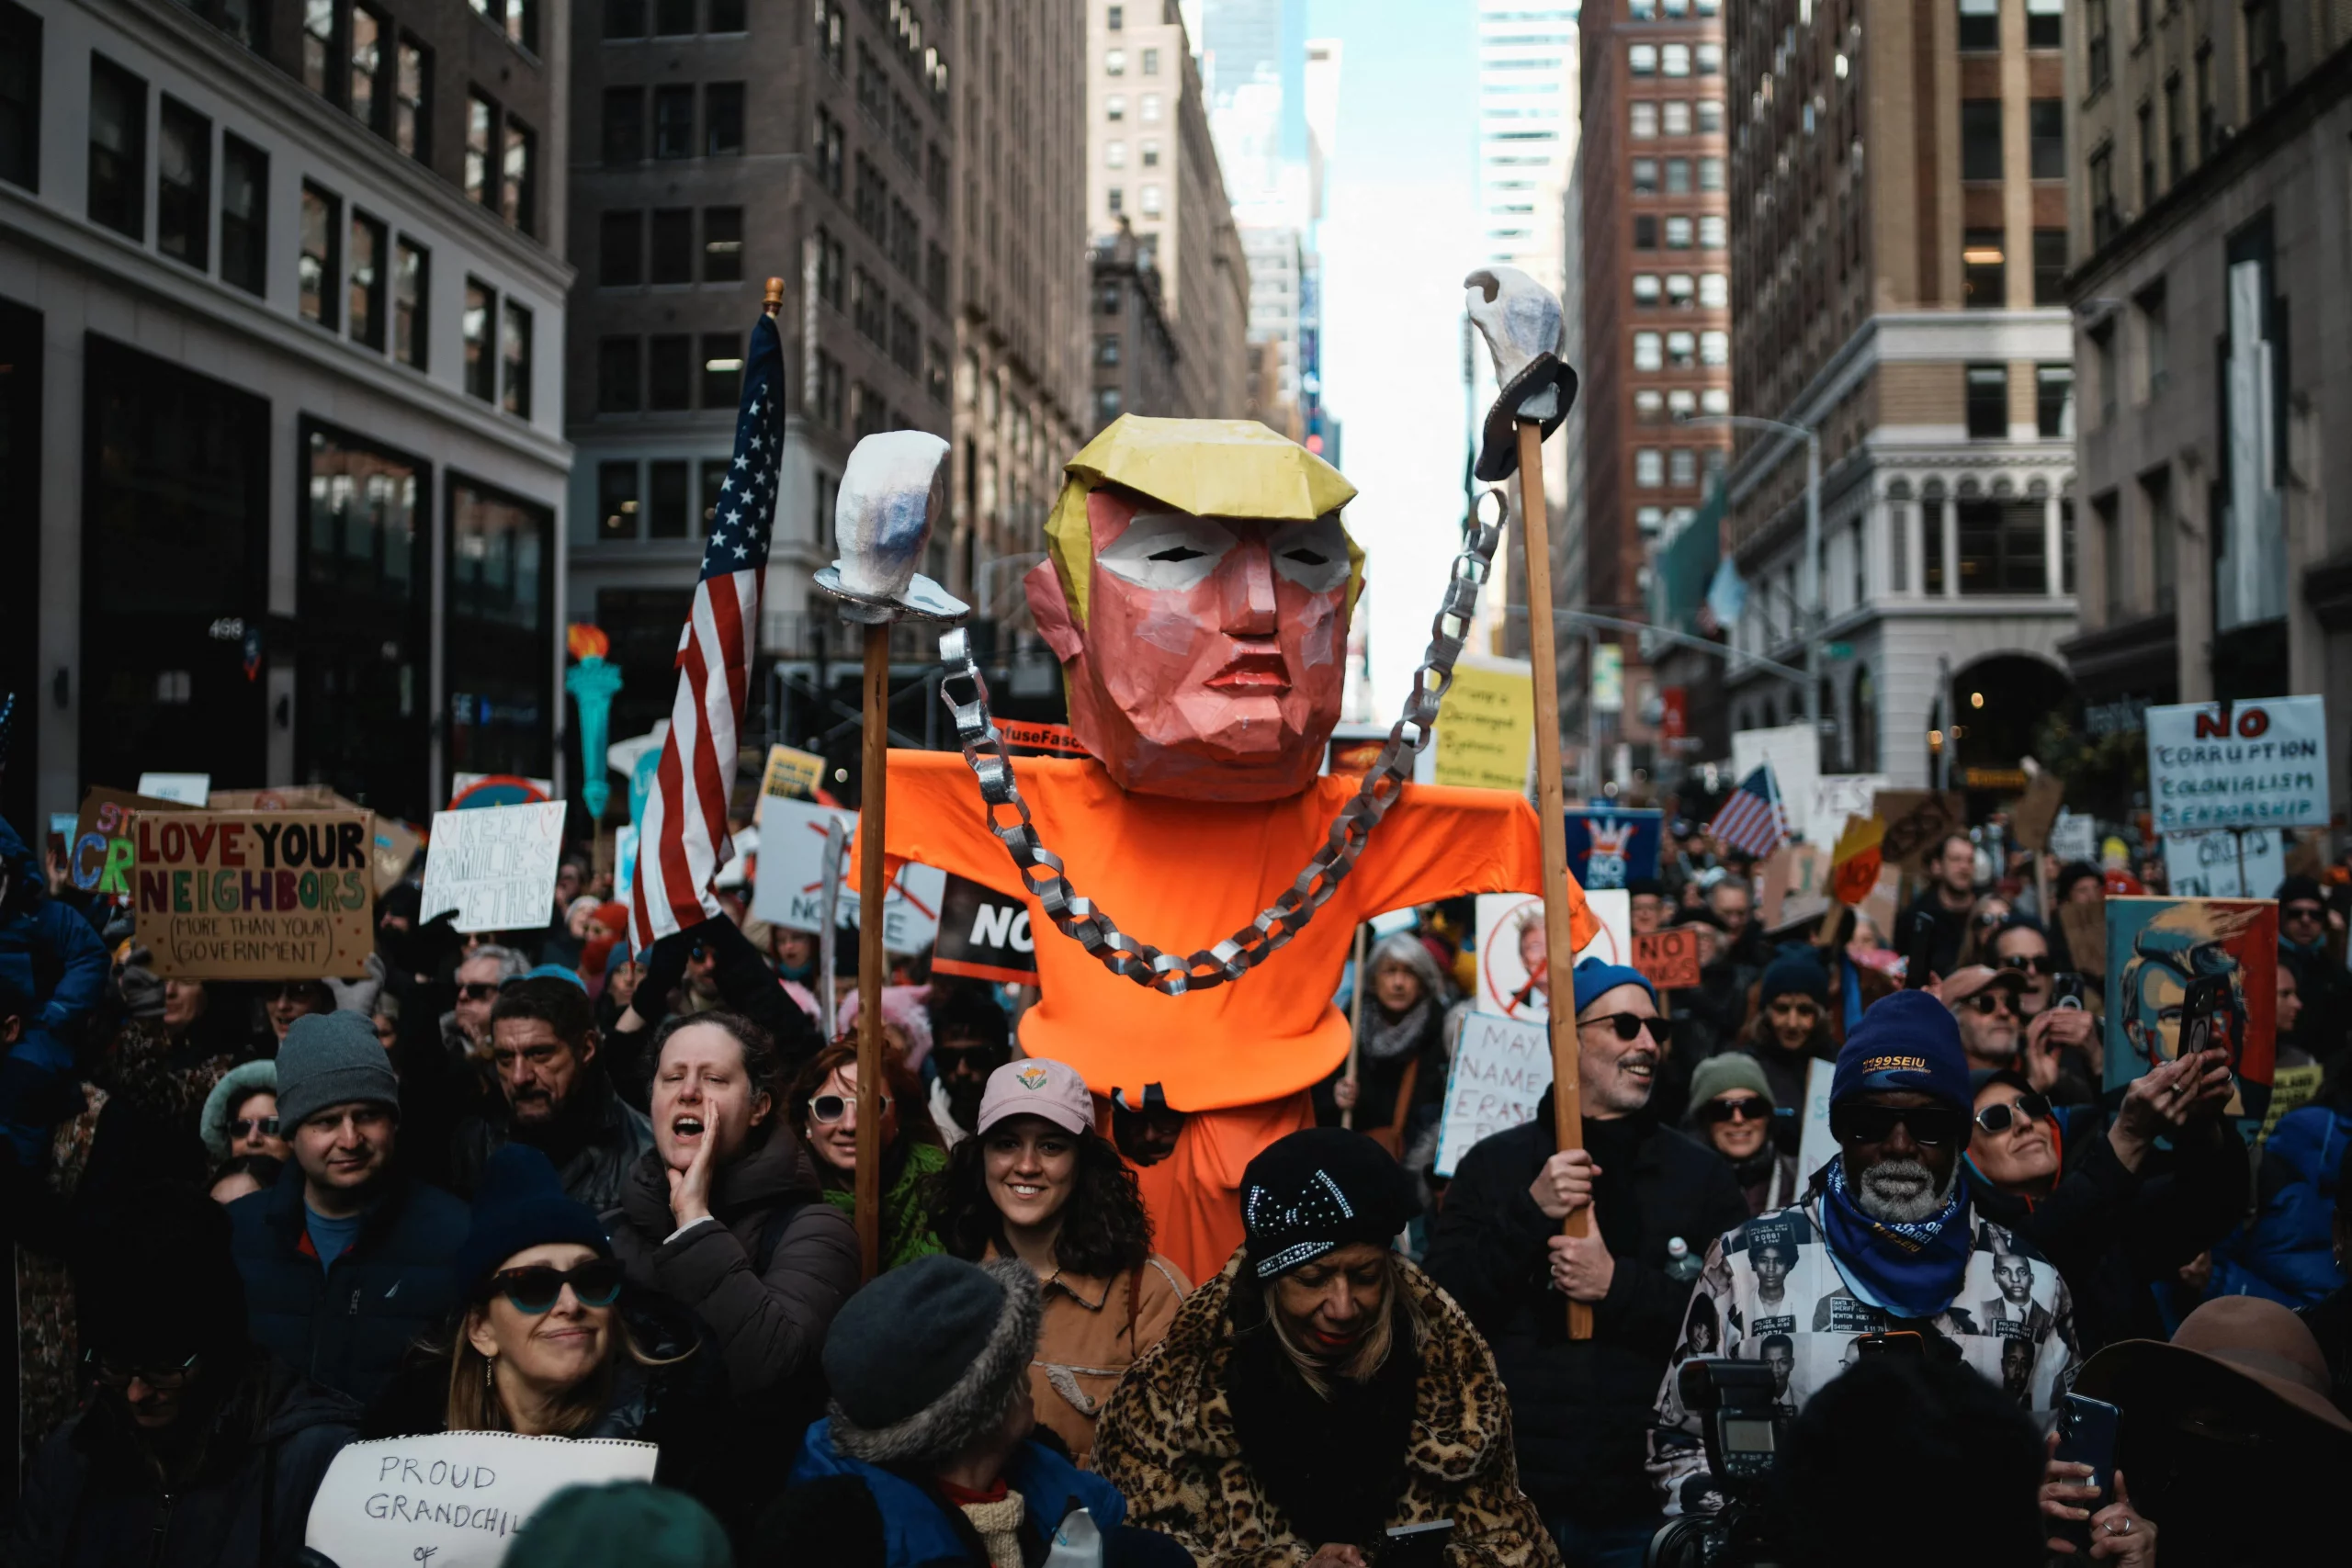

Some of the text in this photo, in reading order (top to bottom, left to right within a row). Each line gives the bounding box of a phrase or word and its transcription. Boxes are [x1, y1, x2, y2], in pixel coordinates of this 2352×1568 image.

[999, 725, 1085, 750] fuseFasc
[2194, 706, 2270, 740] NO
[2159, 739, 2317, 767] CORRUPTION
[2161, 772, 2314, 798] COLONIALISM
[96, 802, 135, 837] ST
[460, 805, 539, 844] KEEP
[139, 821, 366, 868] LOVE YOUR
[74, 832, 134, 893] CR
[426, 840, 553, 886] FAMILIES
[140, 870, 366, 913] NEIGHBORS
[232, 918, 276, 936] THAN
[282, 918, 325, 937] YOUR
[1640, 932, 1685, 959] NO
[1481, 1024, 1541, 1061] MAY
[1459, 1055, 1541, 1094] NAME
[1862, 1055, 1926, 1069] 1199SEIU
[1918, 1221, 1943, 1235] OR
[379, 1455, 496, 1489] PROUD
[365, 1493, 525, 1539] GRANDCHIL
[413, 1546, 439, 1568] OF
